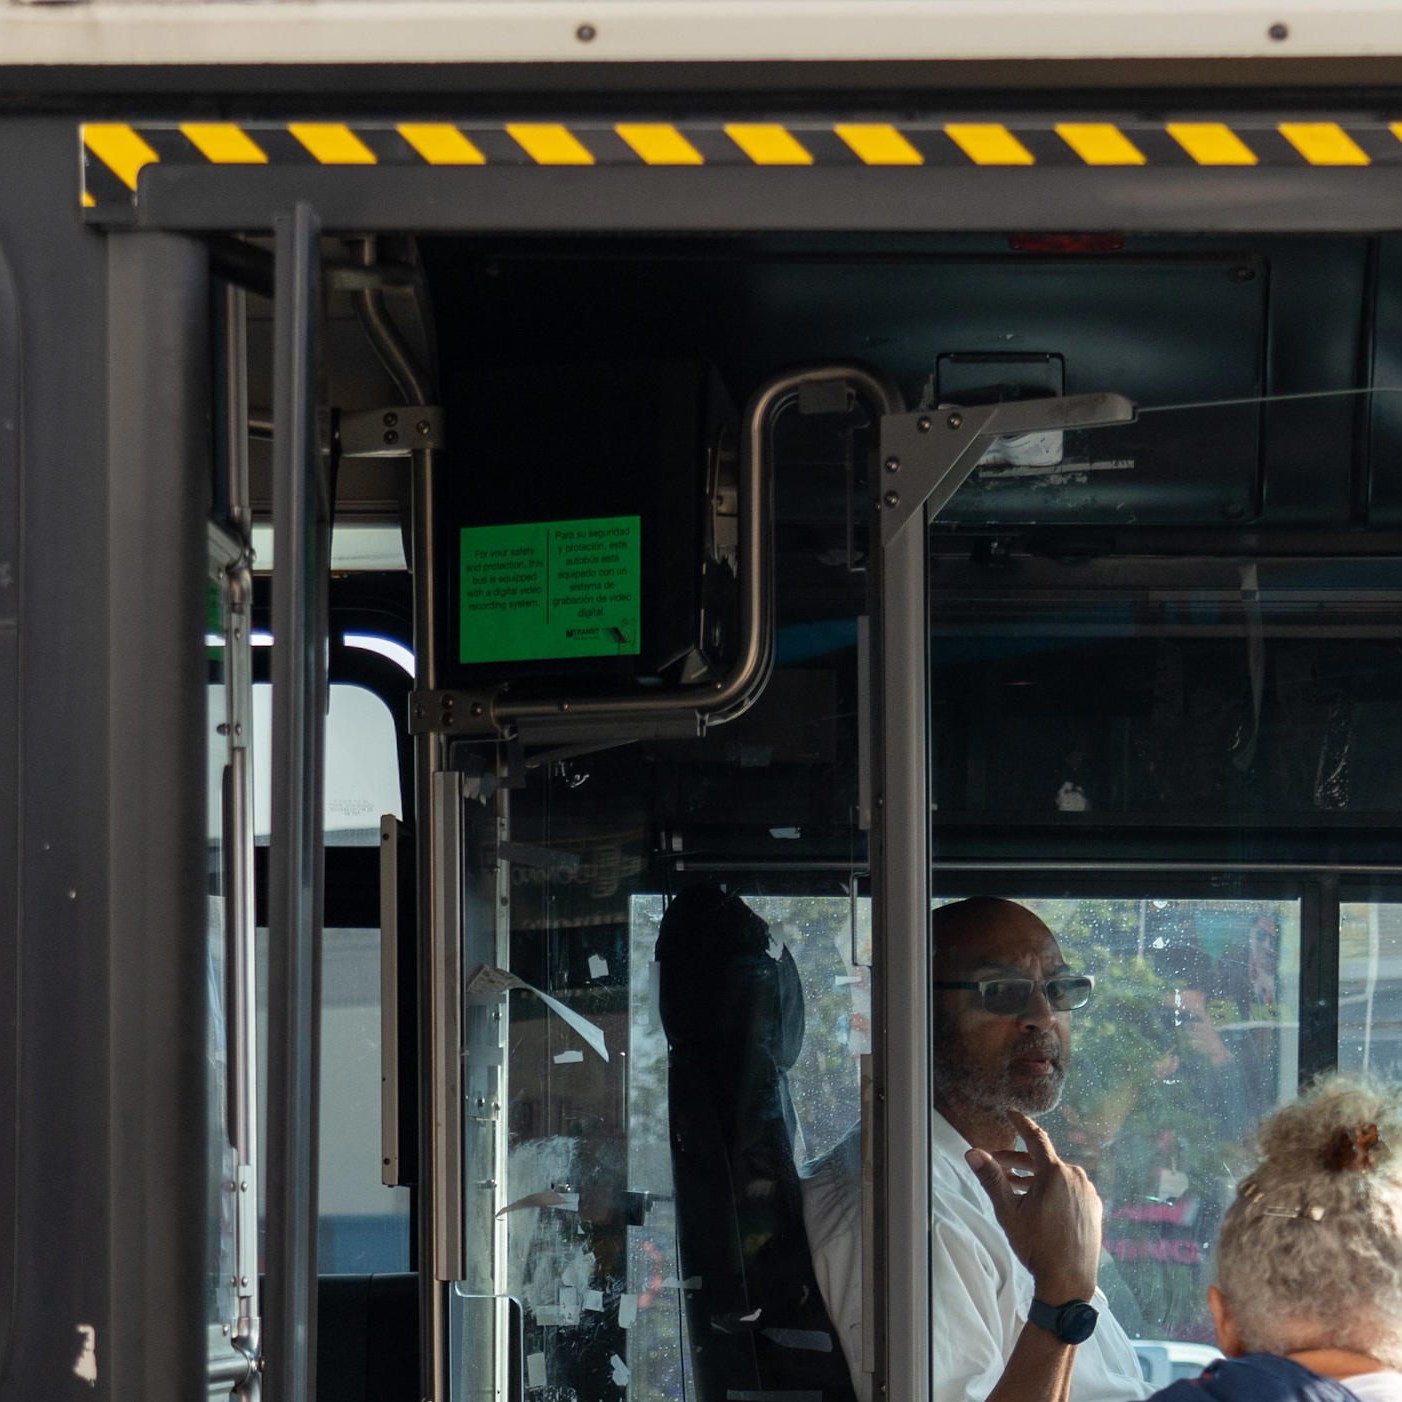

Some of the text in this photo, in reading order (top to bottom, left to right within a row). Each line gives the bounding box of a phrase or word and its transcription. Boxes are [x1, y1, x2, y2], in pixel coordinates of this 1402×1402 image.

[555, 530, 574, 540] Para
[588, 527, 630, 539] seguridad
[474, 549, 488, 559] For
[466, 563, 481, 572] and
[528, 559, 543, 569] this
[472, 575, 487, 584] bus
[498, 572, 537, 584] equipped
[598, 569, 614, 577] con
[467, 589, 484, 598] with
[493, 587, 517, 598] digital
[519, 585, 543, 595] video
[468, 601, 506, 611] recording
